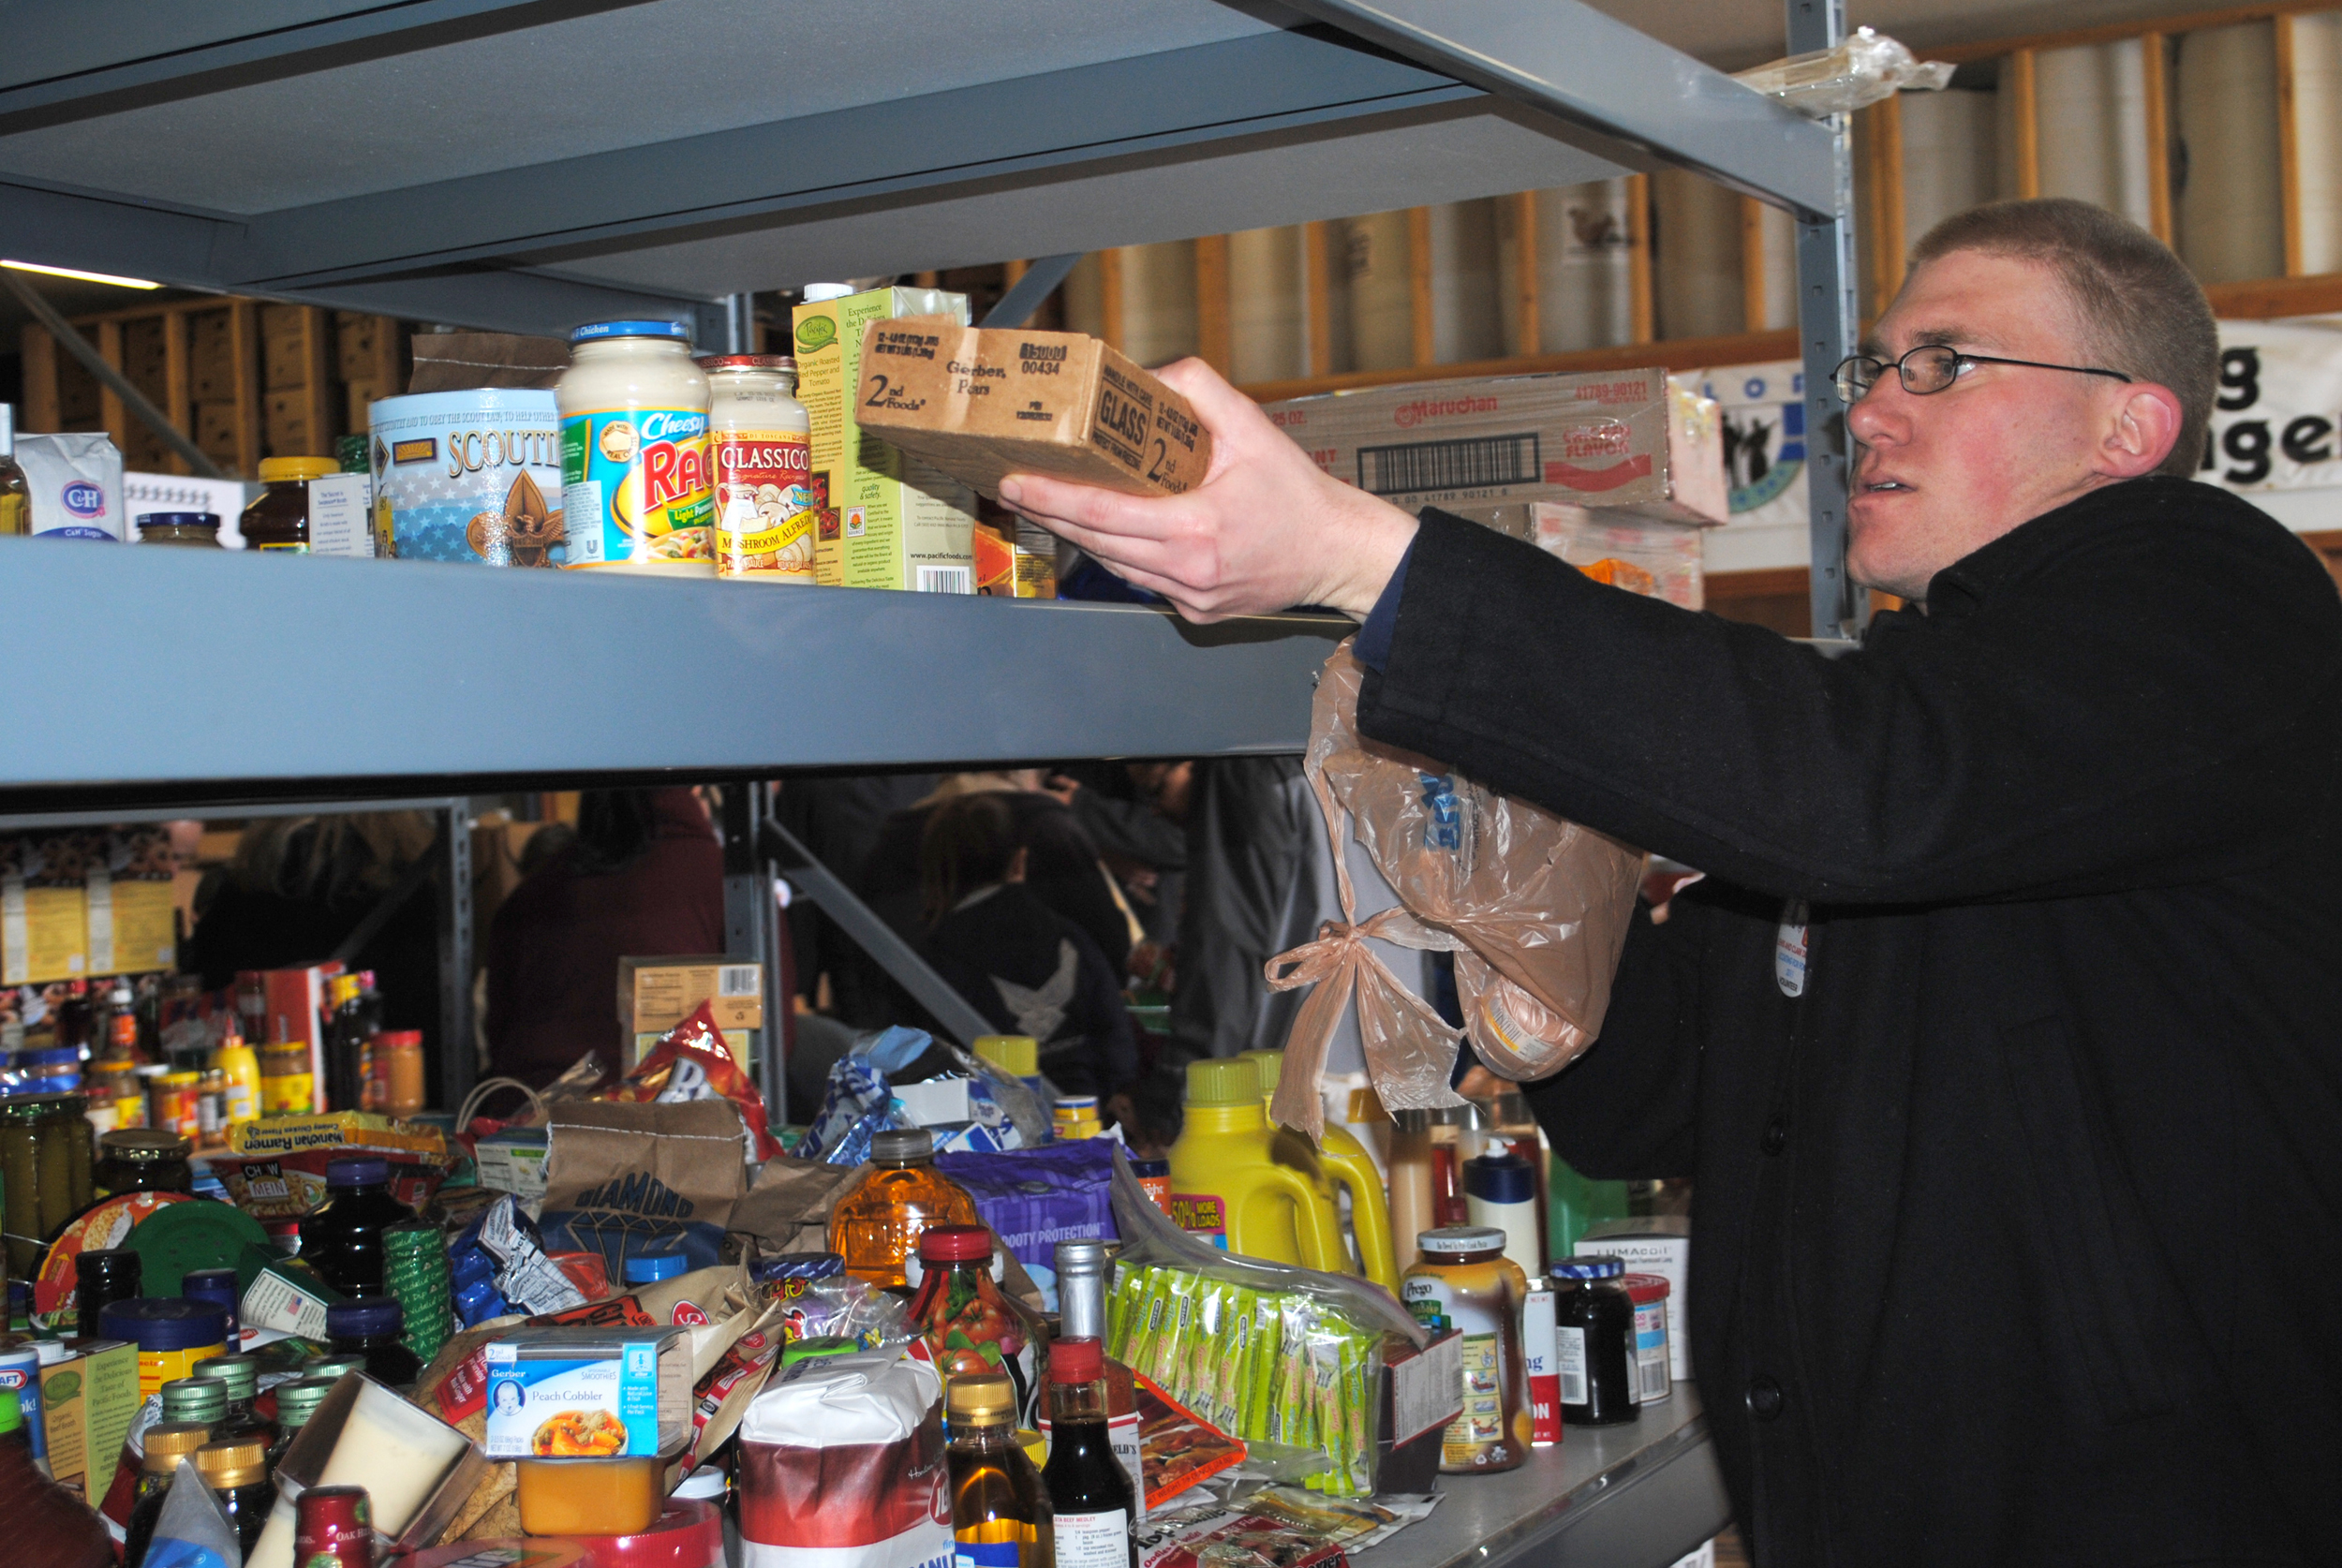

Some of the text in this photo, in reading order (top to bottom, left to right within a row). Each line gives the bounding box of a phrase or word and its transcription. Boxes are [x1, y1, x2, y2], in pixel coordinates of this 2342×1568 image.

[848, 305, 882, 317] Experience
[580, 325, 609, 336] Chicken
[820, 355, 840, 365] Roasted
[810, 365, 840, 378] Pepper and
[1022, 362, 1061, 375] 00434
[809, 378, 830, 387] Tomato
[1410, 396, 1498, 419] Maruchan
[447, 412, 460, 424] THE
[1100, 390, 1147, 447] GLASS
[641, 413, 704, 440] Cheesy
[448, 429, 560, 477] SCOUTI
[720, 446, 808, 471] CLASSICO
[861, 483, 880, 492] quality
[68, 489, 98, 508] C&H
[1424, 492, 1456, 503] 41789
[1462, 489, 1495, 499] 90121
[674, 509, 694, 523] Light
[782, 514, 812, 540] ALFREDO
[722, 535, 780, 549] MSHROOM
[748, 559, 764, 568] SAUCE
[244, 1139, 292, 1150] Ramen
[252, 1183, 284, 1197] MEIN
[575, 1171, 695, 1218] DIAMOND
[1196, 1201, 1216, 1213] MORE
[1197, 1214, 1221, 1228] LOADS
[1038, 1222, 1104, 1242] PROTECTION
[1407, 1282, 1432, 1298] Prego
[96, 1357, 130, 1371] Experience
[491, 1369, 526, 1379] Gerber
[581, 1372, 617, 1381] SMOOTHIES
[532, 1390, 603, 1401] Peach Cobbler
[336, 1531, 356, 1542] OAK
[1144, 1546, 1171, 1568] Oodles
